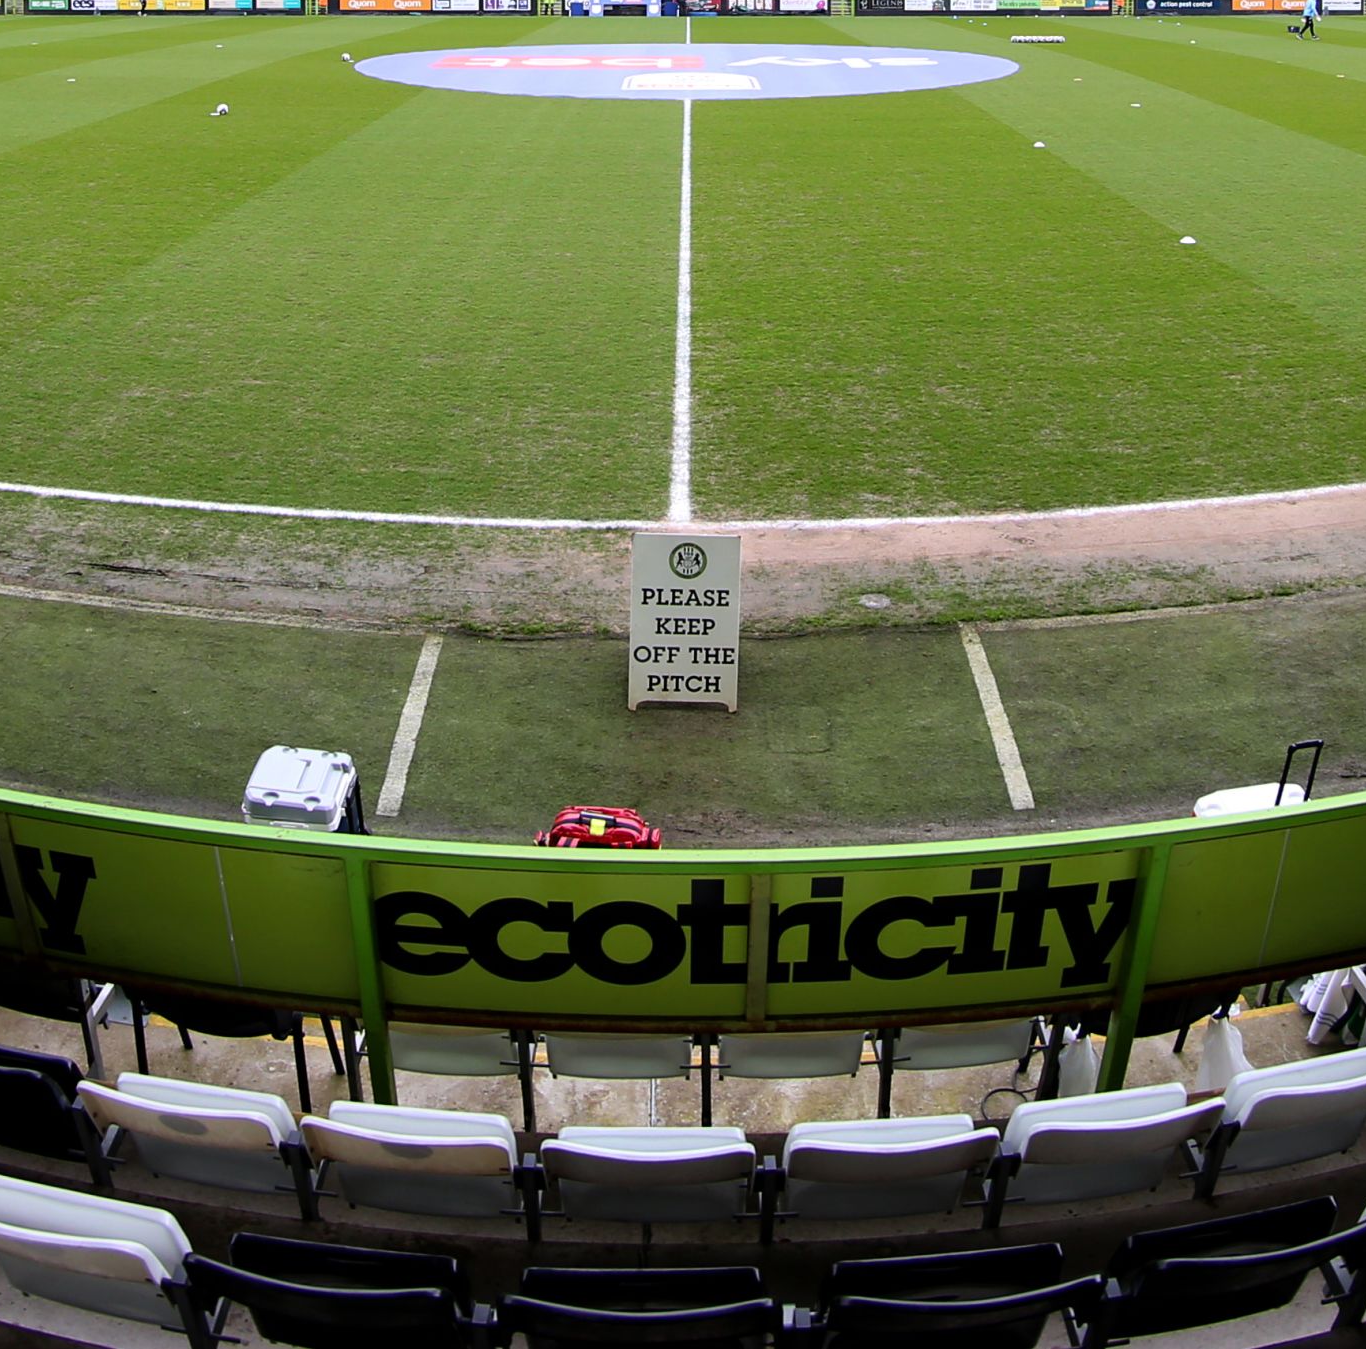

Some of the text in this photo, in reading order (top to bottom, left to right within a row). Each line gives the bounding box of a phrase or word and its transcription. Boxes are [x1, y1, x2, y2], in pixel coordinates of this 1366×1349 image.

[1160, 0, 1213, 9] action pest control
[1239, 0, 1265, 9] Quorn
[641, 588, 729, 607] PLEASE
[655, 618, 716, 635] KEEP
[634, 645, 735, 665] OFF THE
[647, 675, 721, 693] PITCH
[374, 863, 1135, 989] ecotricity
